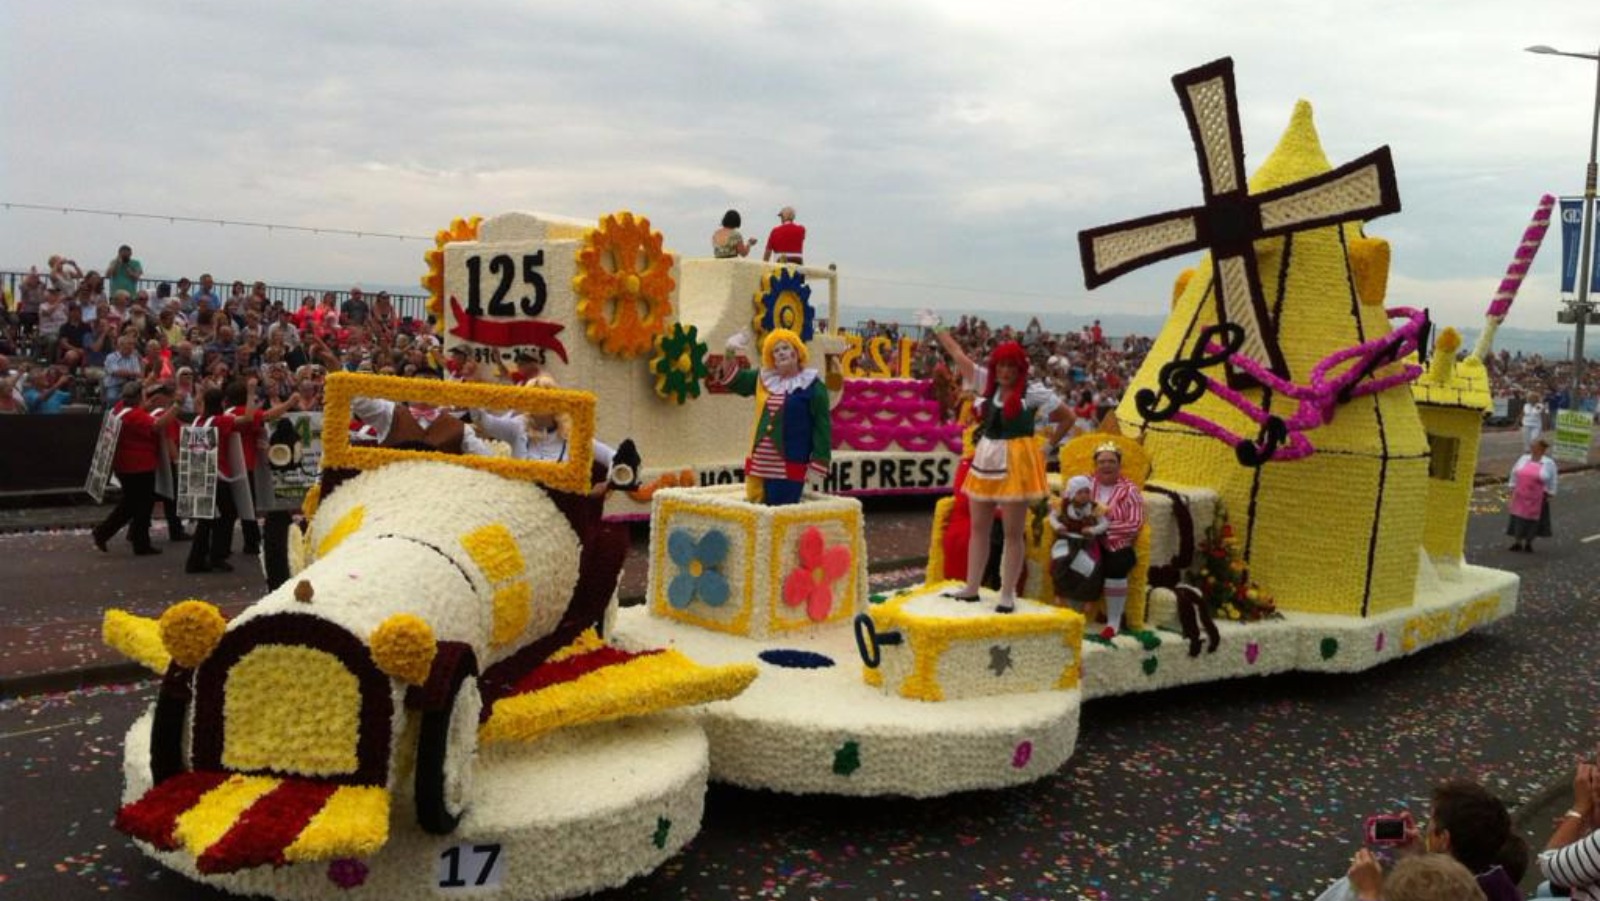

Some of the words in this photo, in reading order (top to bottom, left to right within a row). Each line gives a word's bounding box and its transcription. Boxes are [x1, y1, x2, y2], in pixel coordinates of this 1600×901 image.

[466, 249, 547, 317] 125
[812, 461, 852, 492] HE
[861, 457, 951, 489] PRESS
[439, 843, 501, 887] 17
